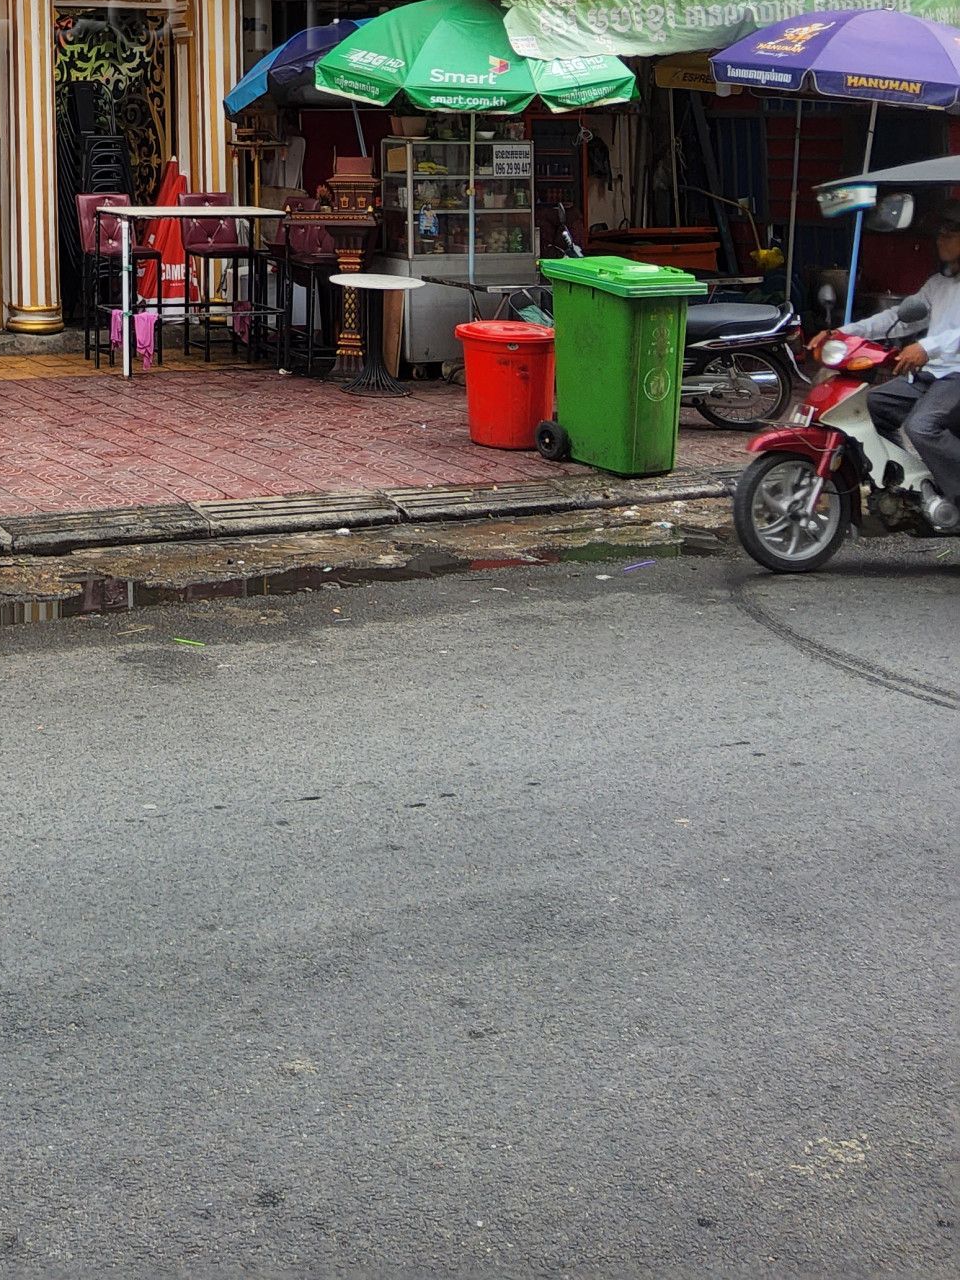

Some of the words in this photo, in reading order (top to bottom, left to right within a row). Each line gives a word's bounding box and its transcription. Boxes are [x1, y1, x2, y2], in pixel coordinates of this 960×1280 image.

[755, 42, 807, 54] HANUMAN
[429, 67, 497, 86] Smart
[846, 74, 922, 95] HANUMAN
[429, 94, 508, 107] smart.com.kh
